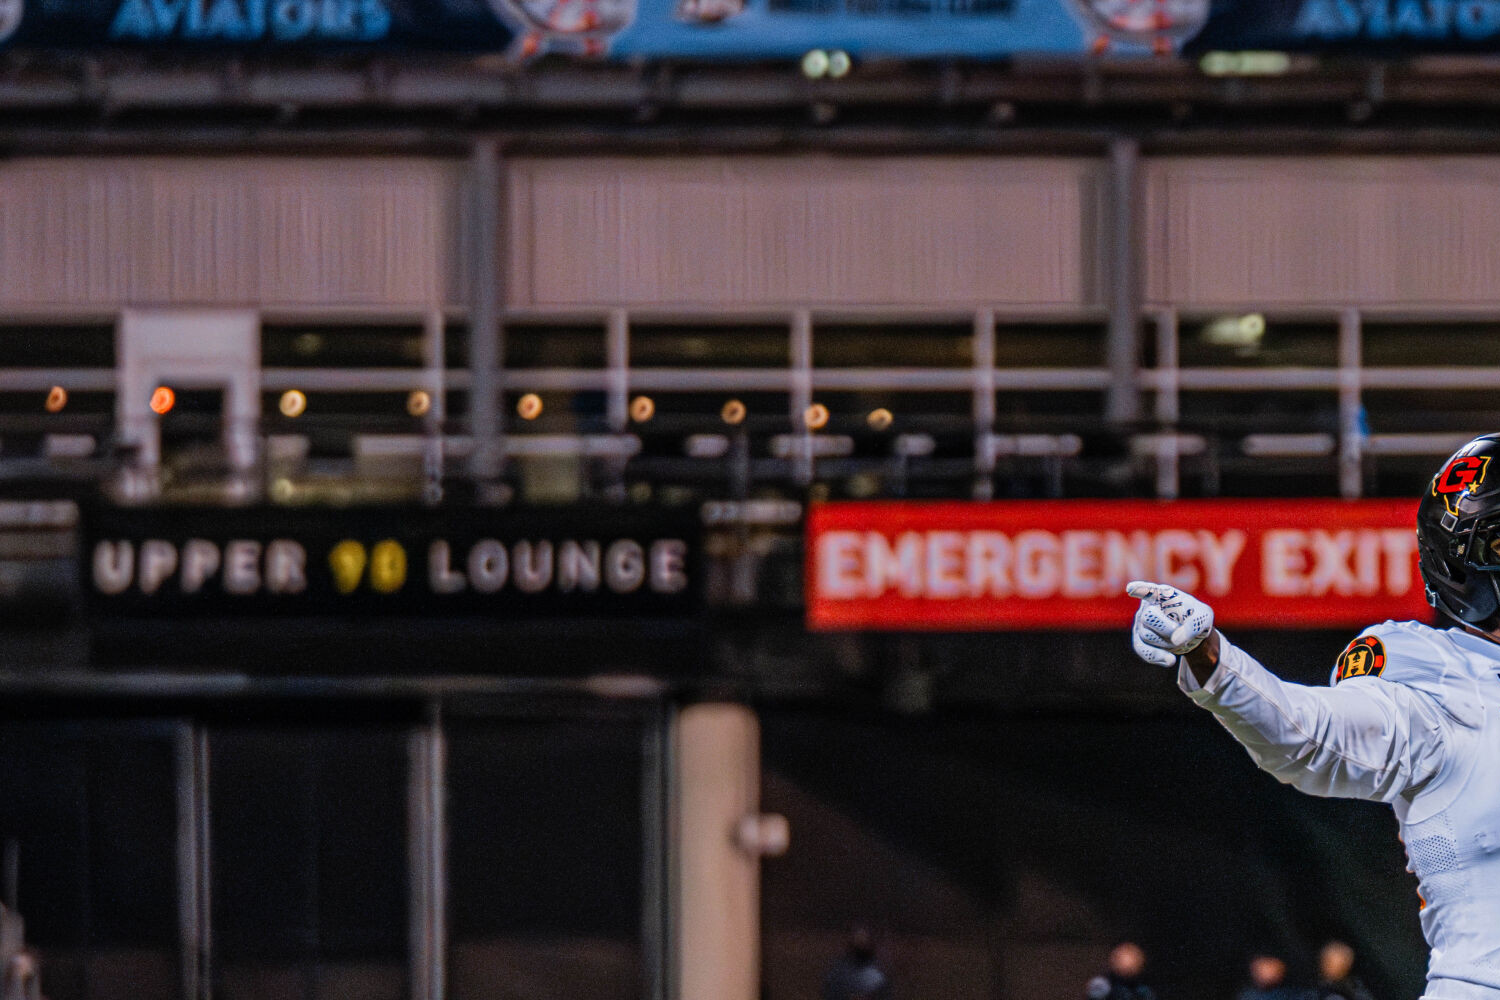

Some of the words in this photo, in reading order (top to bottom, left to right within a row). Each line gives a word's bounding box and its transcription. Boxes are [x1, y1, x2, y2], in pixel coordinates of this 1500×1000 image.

[92, 538, 306, 595] UPPER
[329, 538, 407, 594] 90
[428, 538, 688, 595] LOUNGE
[817, 530, 1246, 599] EMERGENCY
[1260, 529, 1419, 596] EXIT
